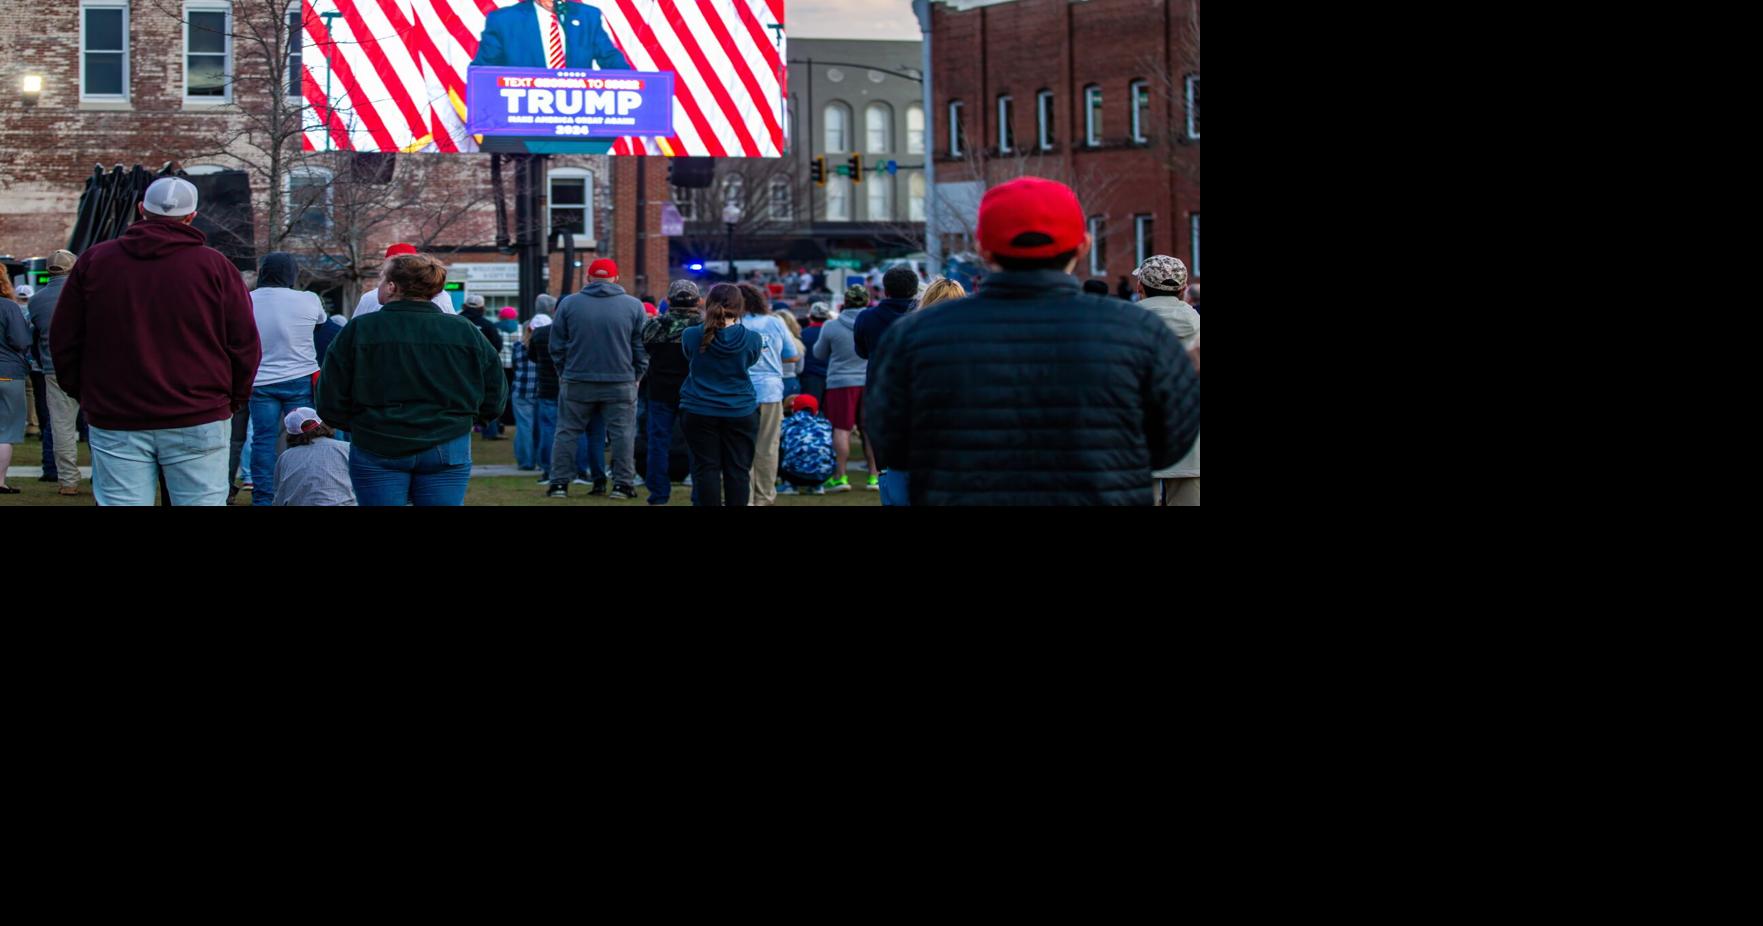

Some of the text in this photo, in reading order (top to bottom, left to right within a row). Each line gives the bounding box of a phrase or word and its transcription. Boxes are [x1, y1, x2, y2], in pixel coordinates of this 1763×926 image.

[503, 77, 532, 87] TEXT
[588, 79, 604, 88] TO
[500, 89, 642, 115] TRUMP
[535, 116, 574, 124] AMERICA
[556, 125, 589, 135] 2024
